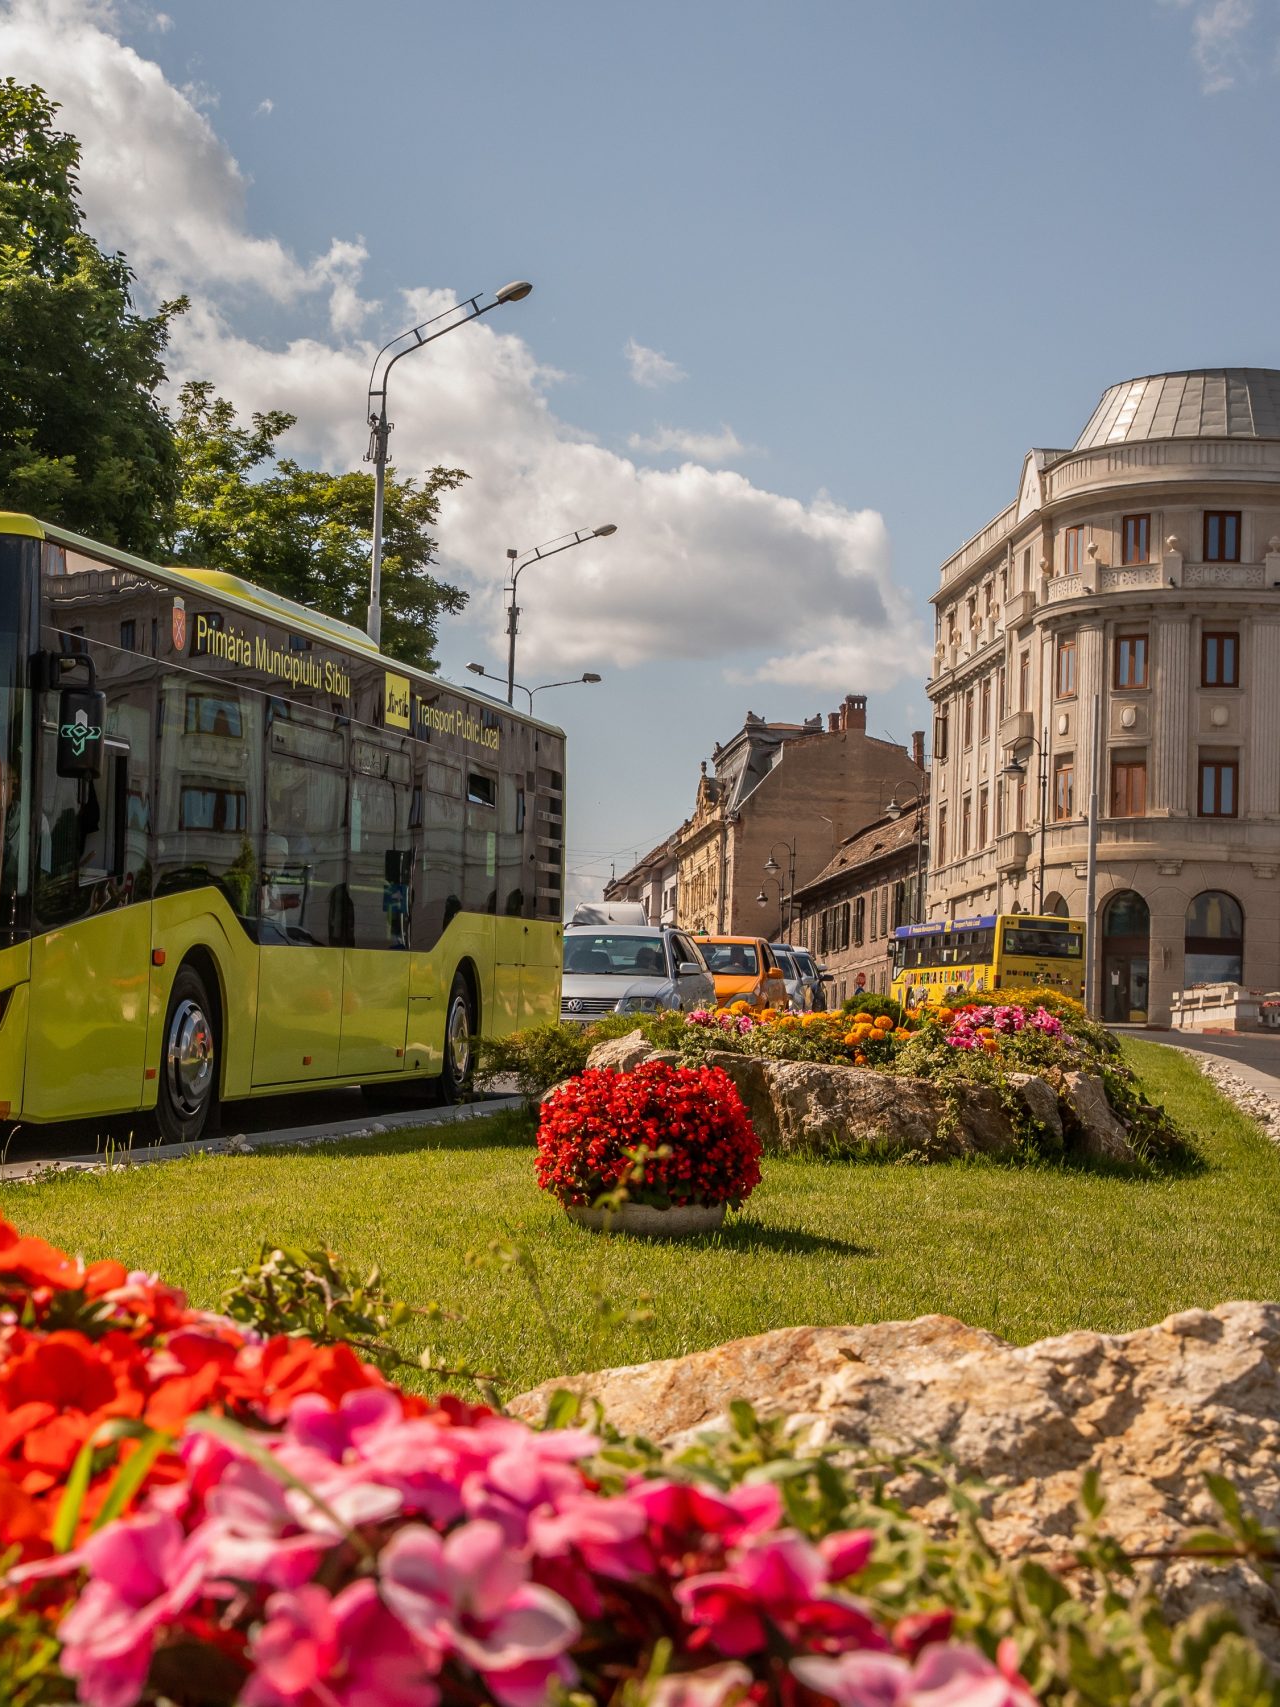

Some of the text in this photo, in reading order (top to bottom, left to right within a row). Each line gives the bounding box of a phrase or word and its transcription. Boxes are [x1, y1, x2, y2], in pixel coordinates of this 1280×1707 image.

[197, 615, 351, 699] Primăria Municipiului Sibiu
[415, 694, 500, 751] Transport Public Local
